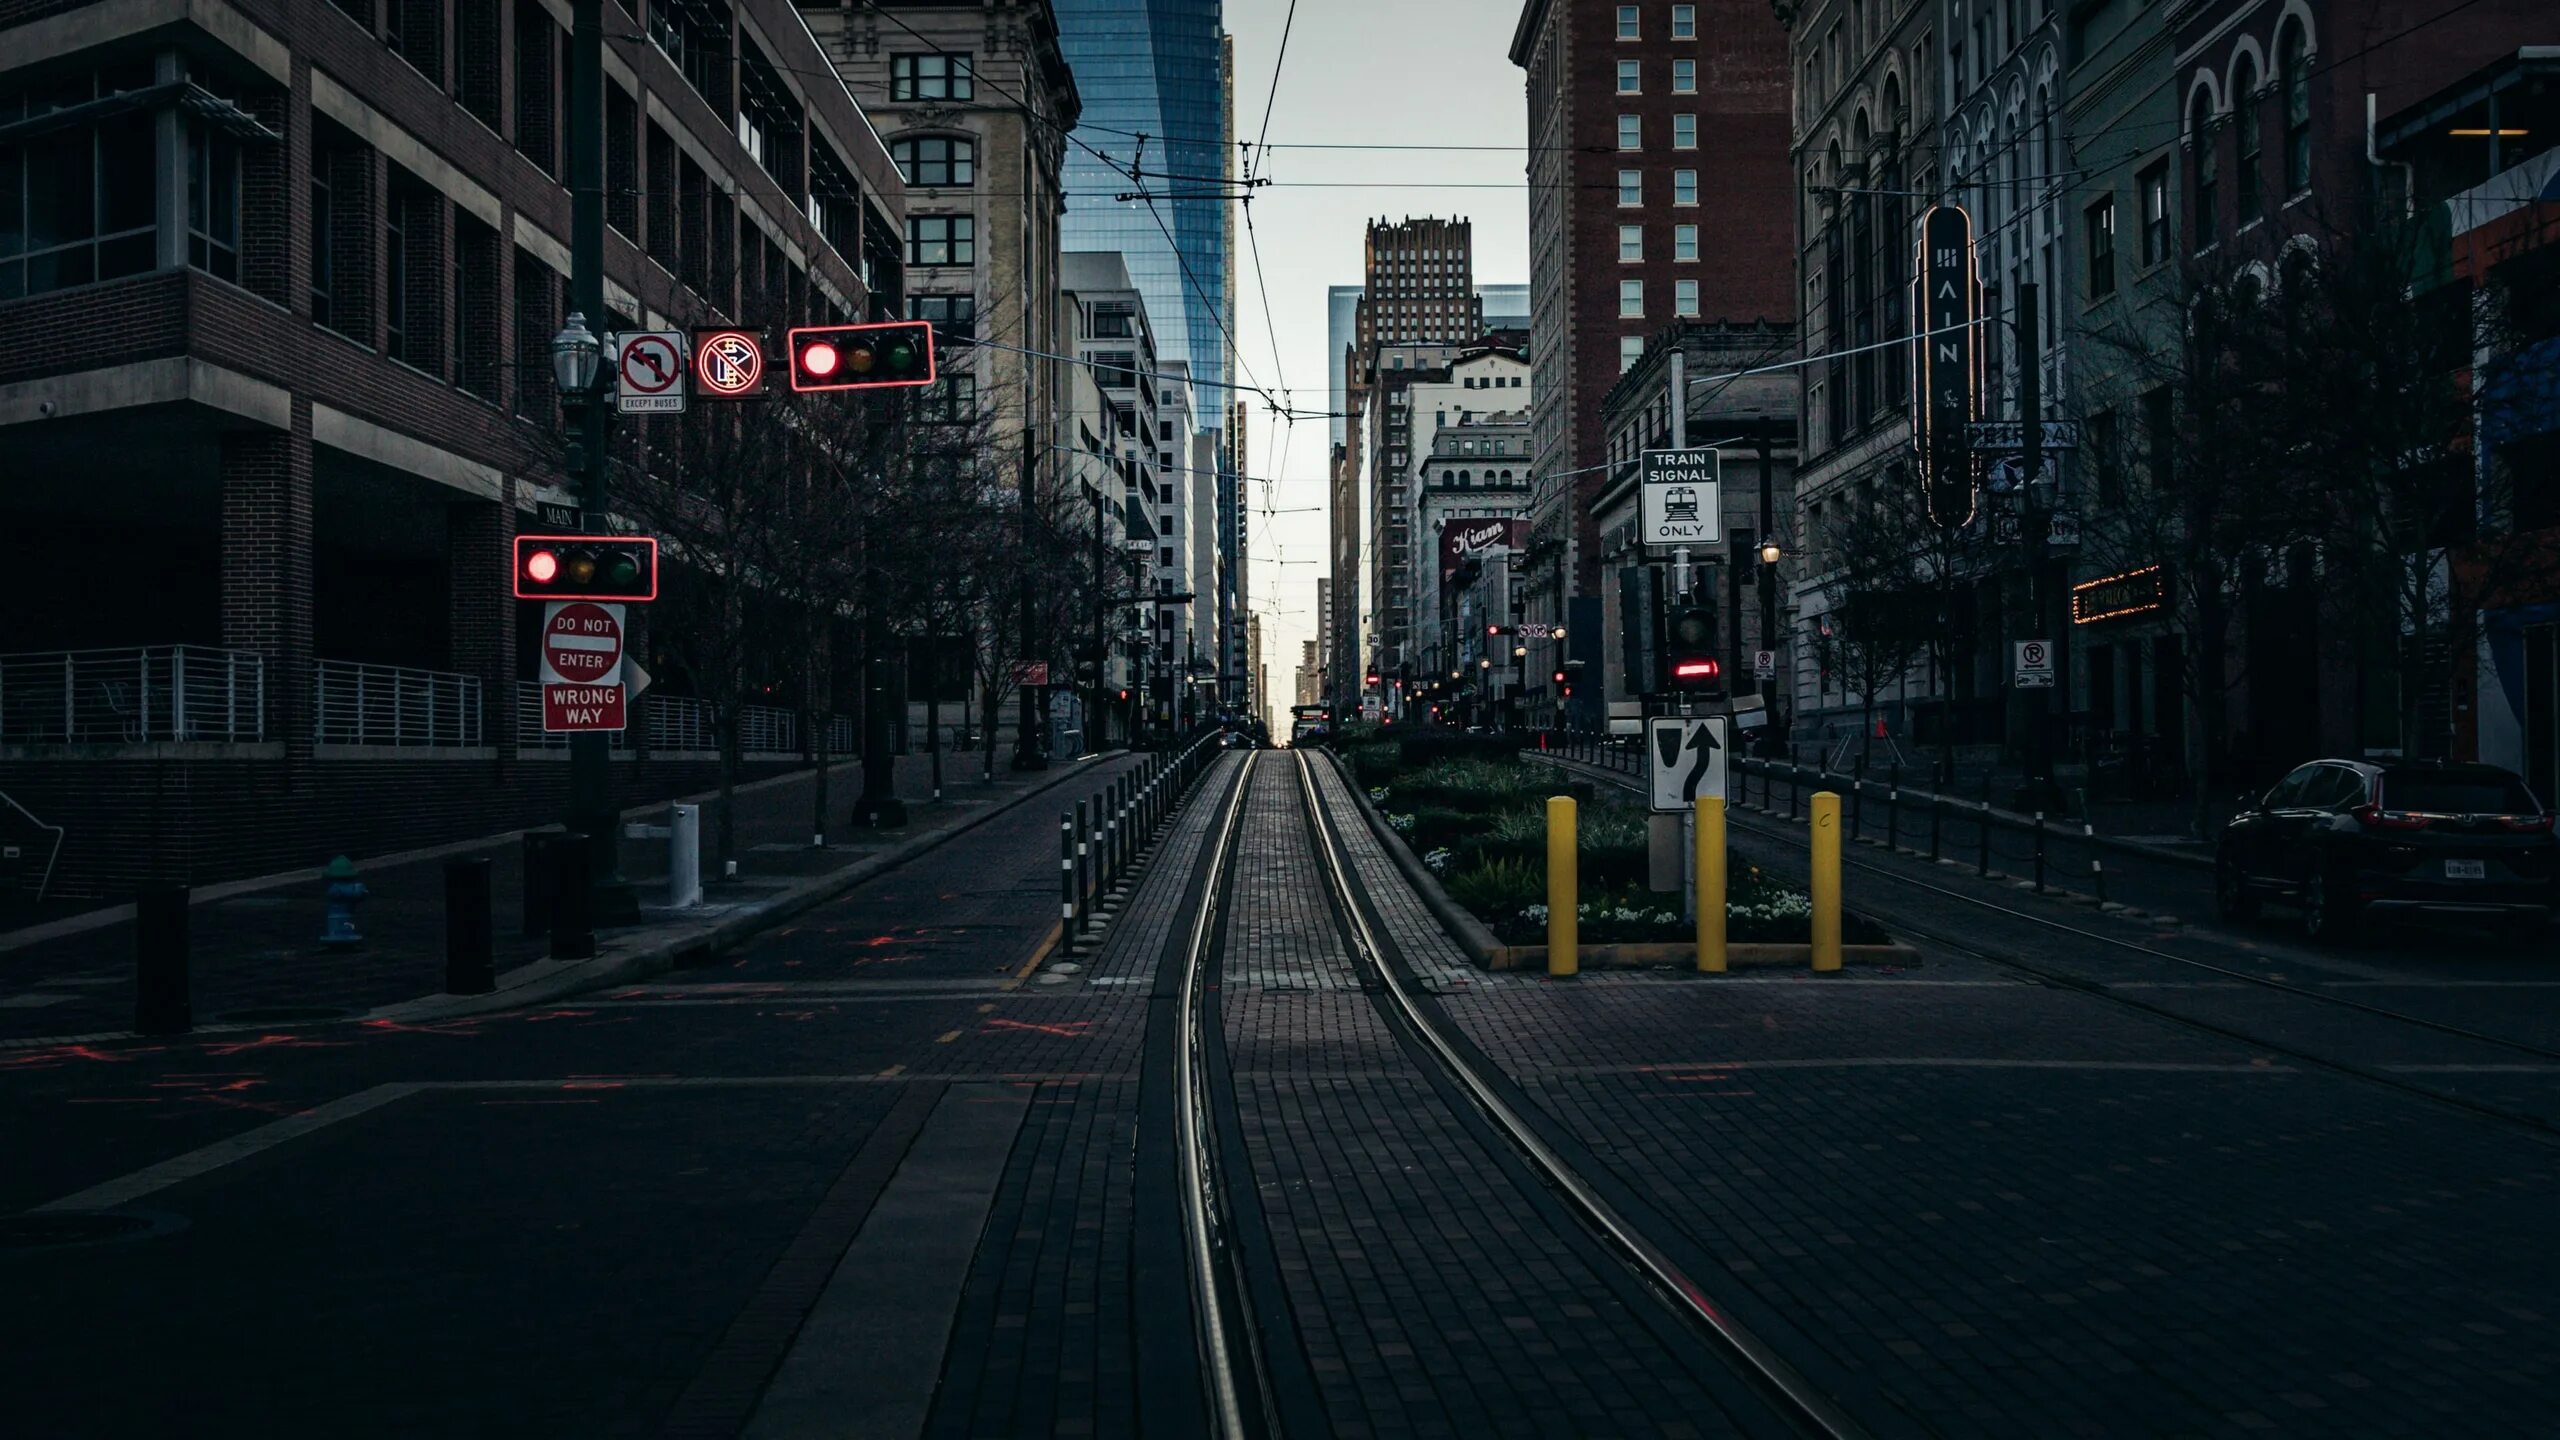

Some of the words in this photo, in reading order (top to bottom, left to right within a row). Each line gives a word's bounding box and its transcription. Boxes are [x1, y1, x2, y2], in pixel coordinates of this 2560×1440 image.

[625, 399, 651, 408] EXCEPT
[655, 399, 678, 408] BUSES
[1654, 453, 1705, 466] TRAIN
[1649, 469, 1712, 482] SIGNAL
[546, 506, 573, 526] MAIN
[1452, 522, 1504, 554] Kiam
[1659, 525, 1704, 537] ONLY
[557, 617, 576, 631] DO
[583, 619, 612, 633] NOT
[559, 653, 604, 669] ENTER
[552, 688, 616, 705] WRONG
[566, 708, 603, 724] WAY
